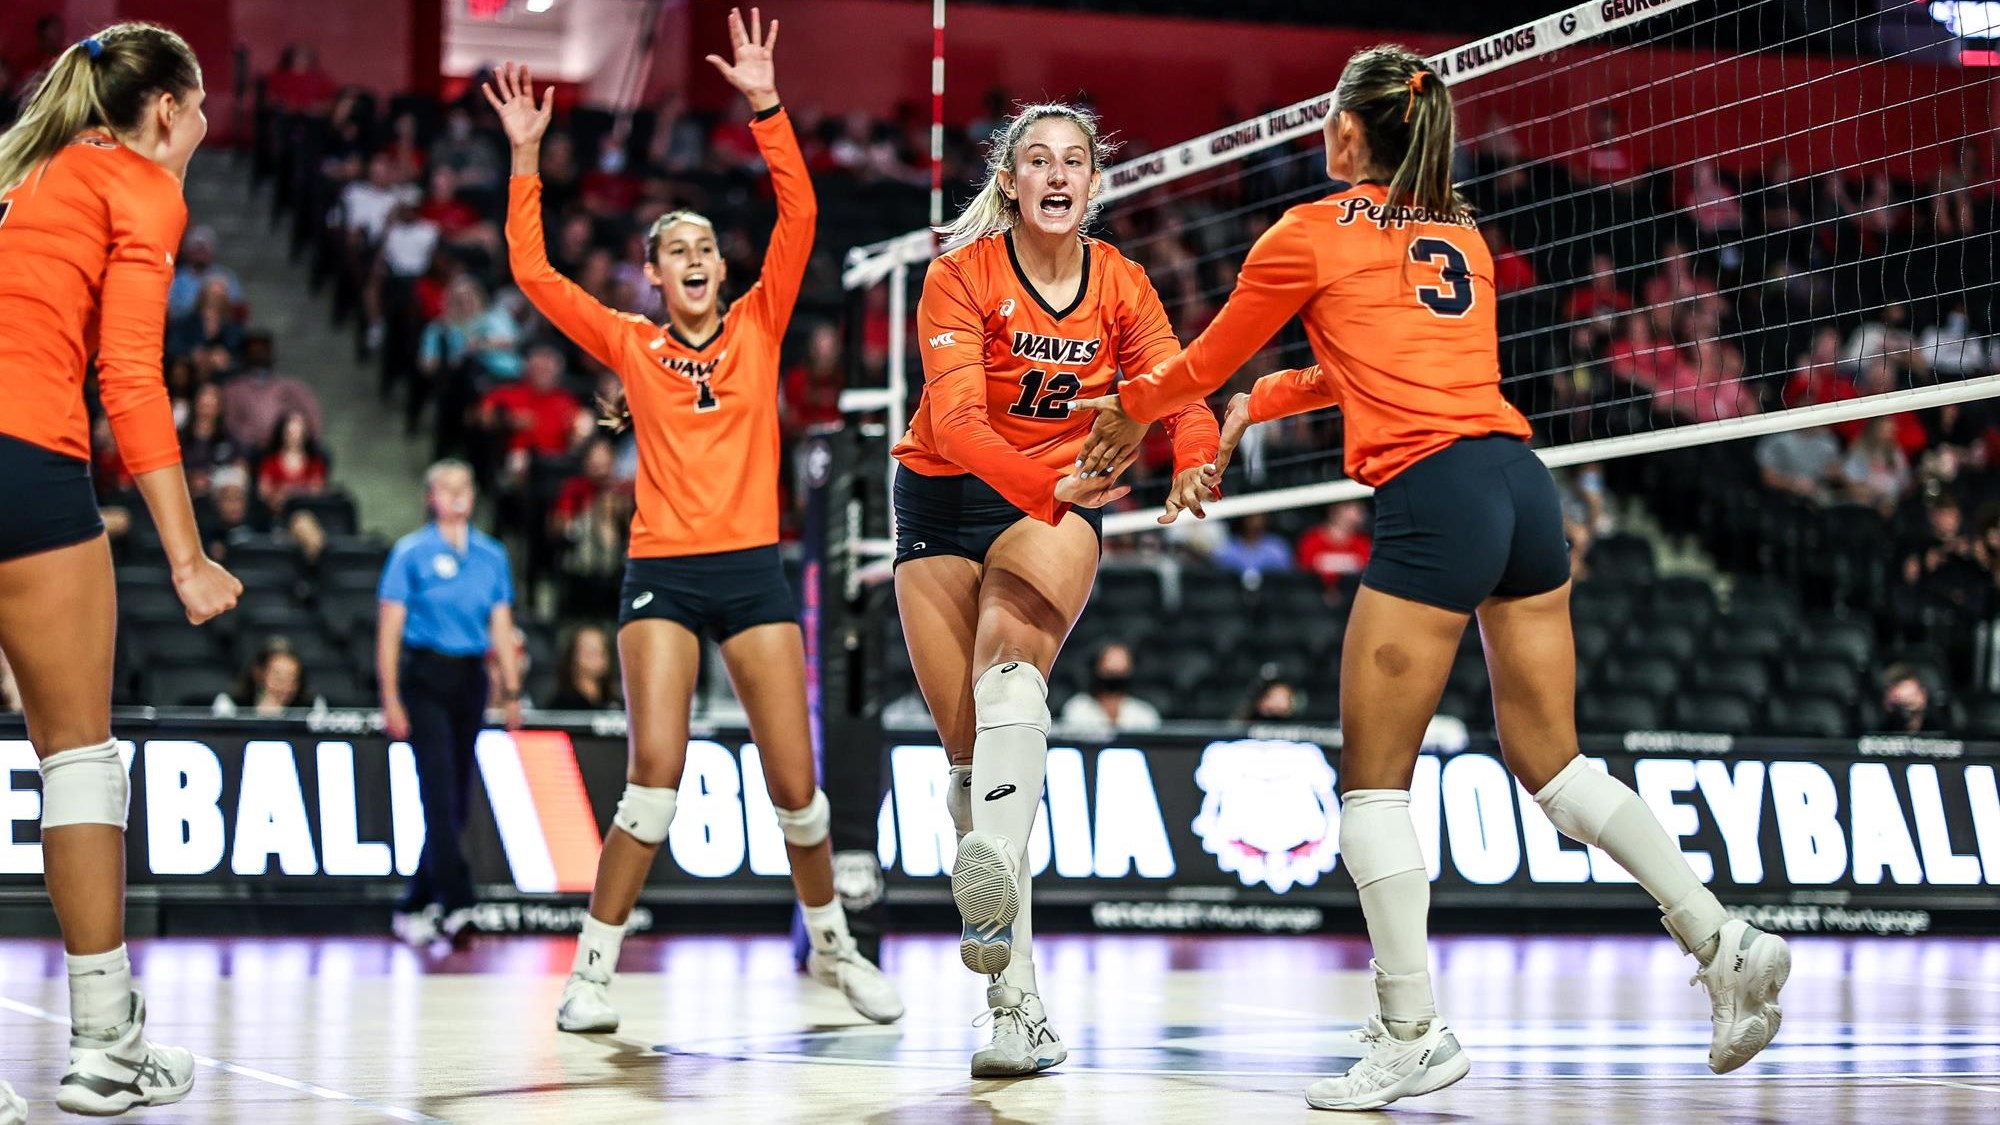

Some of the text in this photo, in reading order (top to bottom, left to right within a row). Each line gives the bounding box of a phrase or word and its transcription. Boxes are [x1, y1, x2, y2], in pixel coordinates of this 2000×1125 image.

[1456, 29, 1536, 73] BULLDOGS
[1559, 13, 1577, 36] G
[1336, 196, 1478, 232] Pepper
[1408, 236, 1476, 318] 3
[1011, 331, 1101, 365] WAVES
[658, 350, 729, 383] WAV
[694, 379, 720, 414] 1
[1008, 369, 1082, 419] 12
[1725, 904, 1821, 931] OCKET
